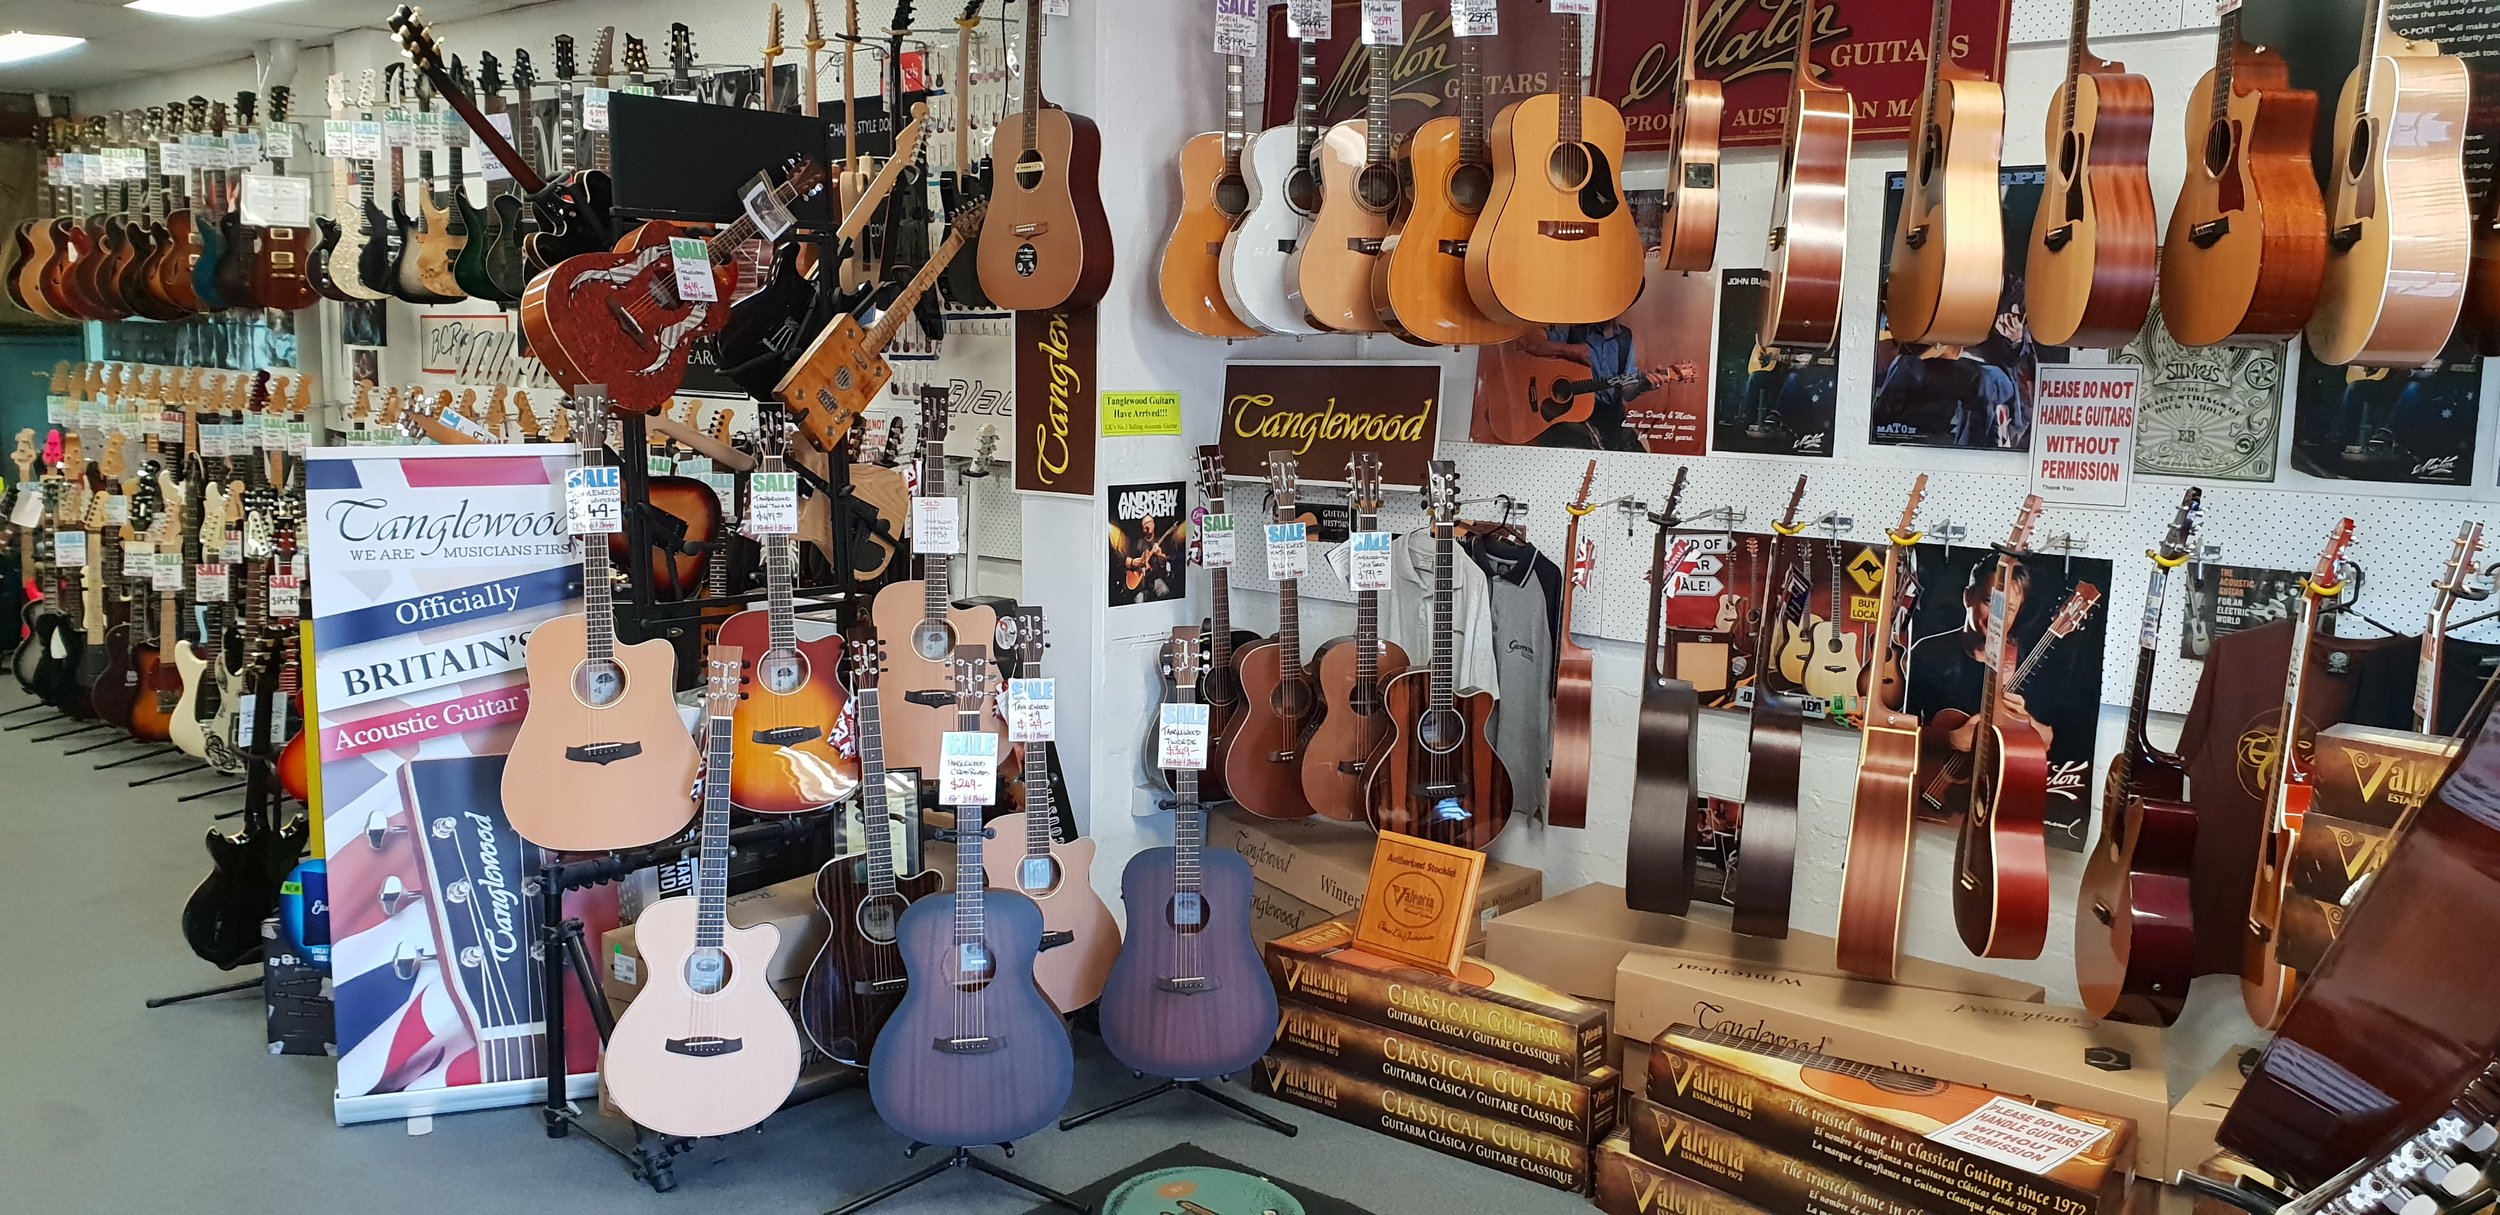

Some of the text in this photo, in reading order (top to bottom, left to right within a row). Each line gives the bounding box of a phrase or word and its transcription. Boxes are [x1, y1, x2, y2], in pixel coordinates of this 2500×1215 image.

[2438, 7, 2464, 17] sound
[2448, 22, 2489, 32] will make
[2457, 34, 2485, 42] clarity
[1831, 35, 1969, 67] GUITAS
[858, 120, 877, 134] STYLE
[1727, 277, 1749, 285] JOHN
[2040, 380, 2134, 399] PLEASE DO NOT
[1106, 395, 1175, 406] Tanglewood Guitars
[1114, 408, 1168, 418] Have Arrived!!!
[2040, 404, 2133, 428] HANDLE GUITARS
[1228, 391, 1433, 457] Tanglewood
[2046, 435, 2120, 456] WITHOUT
[568, 468, 619, 488] SALE
[2041, 459, 2120, 482] PERMISSION
[753, 474, 796, 493] SALE
[1119, 489, 1178, 506] ANDREW
[1118, 502, 1178, 520] WISHART
[1204, 514, 1234, 532] SALE
[1268, 523, 1305, 543] SALE
[1354, 533, 1390, 551] SALE
[1704, 538, 1722, 550] OF
[350, 545, 534, 561] WE ARE MUSICIANS
[197, 564, 226, 576] SALE
[2220, 568, 2234, 577] THE
[270, 576, 300, 589] SALE
[2218, 586, 2245, 597] GUITAR
[2219, 577, 2255, 589] ACOUSTIC
[395, 583, 520, 626] Officially
[1858, 599, 1876, 608] BUY
[2216, 606, 2250, 617] ELECTRIC
[2217, 597, 2244, 607] FOR AN
[2215, 614, 2241, 625] WORLD
[1011, 681, 1053, 700] SALE
[335, 694, 519, 751] Acoustic Guitar
[1163, 705, 1207, 725] SALE
[946, 734, 995, 756] SALE
[950, 778, 982, 791] $249-
[1235, 830, 1294, 874] Tanglewood
[464, 810, 519, 962] Tanglewood
[1277, 955, 1349, 996] Valencia
[1388, 984, 1562, 1049] CLASSICAL GUITAR
[1387, 1007, 1428, 1028] GUITARRA
[1430, 1018, 1464, 1038] CLÁSICA
[1472, 1031, 1511, 1050] GUITARE
[1512, 1041, 1561, 1066] CLASSIQUE
[1262, 1055, 1338, 1100] Valencia
[1383, 1036, 1575, 1114] CLASSICAL GUITAR
[1662, 1050, 1753, 1110] Valencia
[1382, 1062, 1427, 1087] GUITARRA
[1429, 1075, 1467, 1099] CLÁSICA
[1476, 1091, 1519, 1115] GUITARE
[1520, 1104, 1574, 1132] CLASSIQUE
[1692, 1090, 1752, 1120] ESTABLISHED 1972
[1381, 1089, 1574, 1168] CLASSICAL GUITAR
[1975, 1112, 2083, 1149] HANDLE GUITARS
[1988, 1104, 2094, 1138] PLEASE DO NOT
[1650, 1107, 1745, 1172] Valencia
[1953, 1130, 2048, 1162] PERMISSION
[1971, 1124, 2058, 1153] WITHOUT
[1381, 1115, 1427, 1140] GUITARRA
[1428, 1128, 1467, 1152] CLÁSICA
[1475, 1143, 1519, 1168] GUITARE
[1520, 1157, 1573, 1185] CLASSIQUE
[1788, 1098, 1809, 1116] The
[1811, 1109, 1855, 1133] trusted
[1855, 1127, 1887, 1146] name
[1890, 1135, 1903, 1152] in
[1907, 1142, 1964, 1173] Classical
[1964, 1162, 2013, 1192] Guitars
[2016, 1183, 2050, 1206] since
[2053, 1196, 2087, 1215] 1972
[1680, 1151, 1743, 1182] ESTABLISHED 1972
[1812, 1139, 1822, 1150] La
[1824, 1145, 1852, 1163] marque
[1853, 1154, 1863, 1166] de
[1864, 1162, 1900, 1181] confiance
[1902, 1175, 1912, 1186] en
[1913, 1178, 1944, 1198] Guitare
[1946, 1190, 1985, 1212] Classique
[1814, 1126, 1823, 1135] El
[1824, 1130, 1852, 1147] nombre
[1853, 1140, 1863, 1151] de
[1864, 1146, 1901, 1166] confianza
[1903, 1161, 1914, 1170] en
[1915, 1165, 1954, 1186] Guitarras
[1991, 1191, 2015, 1208] desde
[2016, 1201, 2038, 1215] 1972
[1781, 1159, 1903, 1215] The trusted name in
[1808, 1189, 1848, 1212] El nombre
